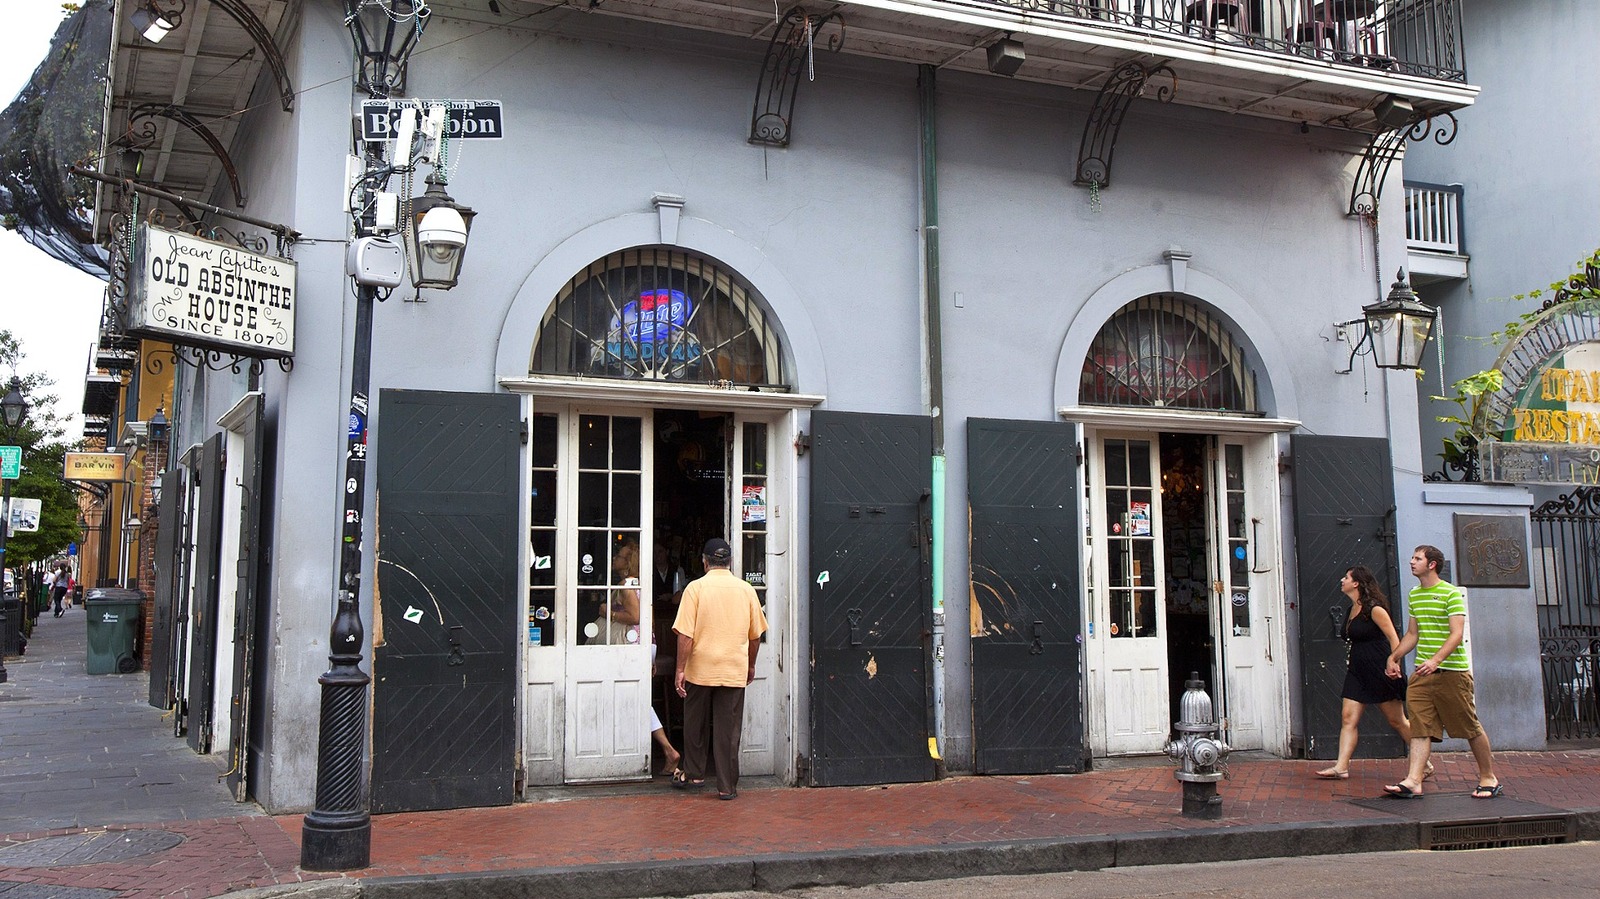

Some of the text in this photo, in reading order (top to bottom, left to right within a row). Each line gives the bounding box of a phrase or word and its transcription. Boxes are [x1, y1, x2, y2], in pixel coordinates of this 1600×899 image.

[395, 101, 470, 109] Rue Bbon
[369, 112, 497, 134] Bbon
[152, 256, 291, 310] OLD ABSINTHE
[187, 293, 258, 330] HOUSE
[166, 315, 275, 346] SINCE 1807
[606, 341, 658, 359] MAD
